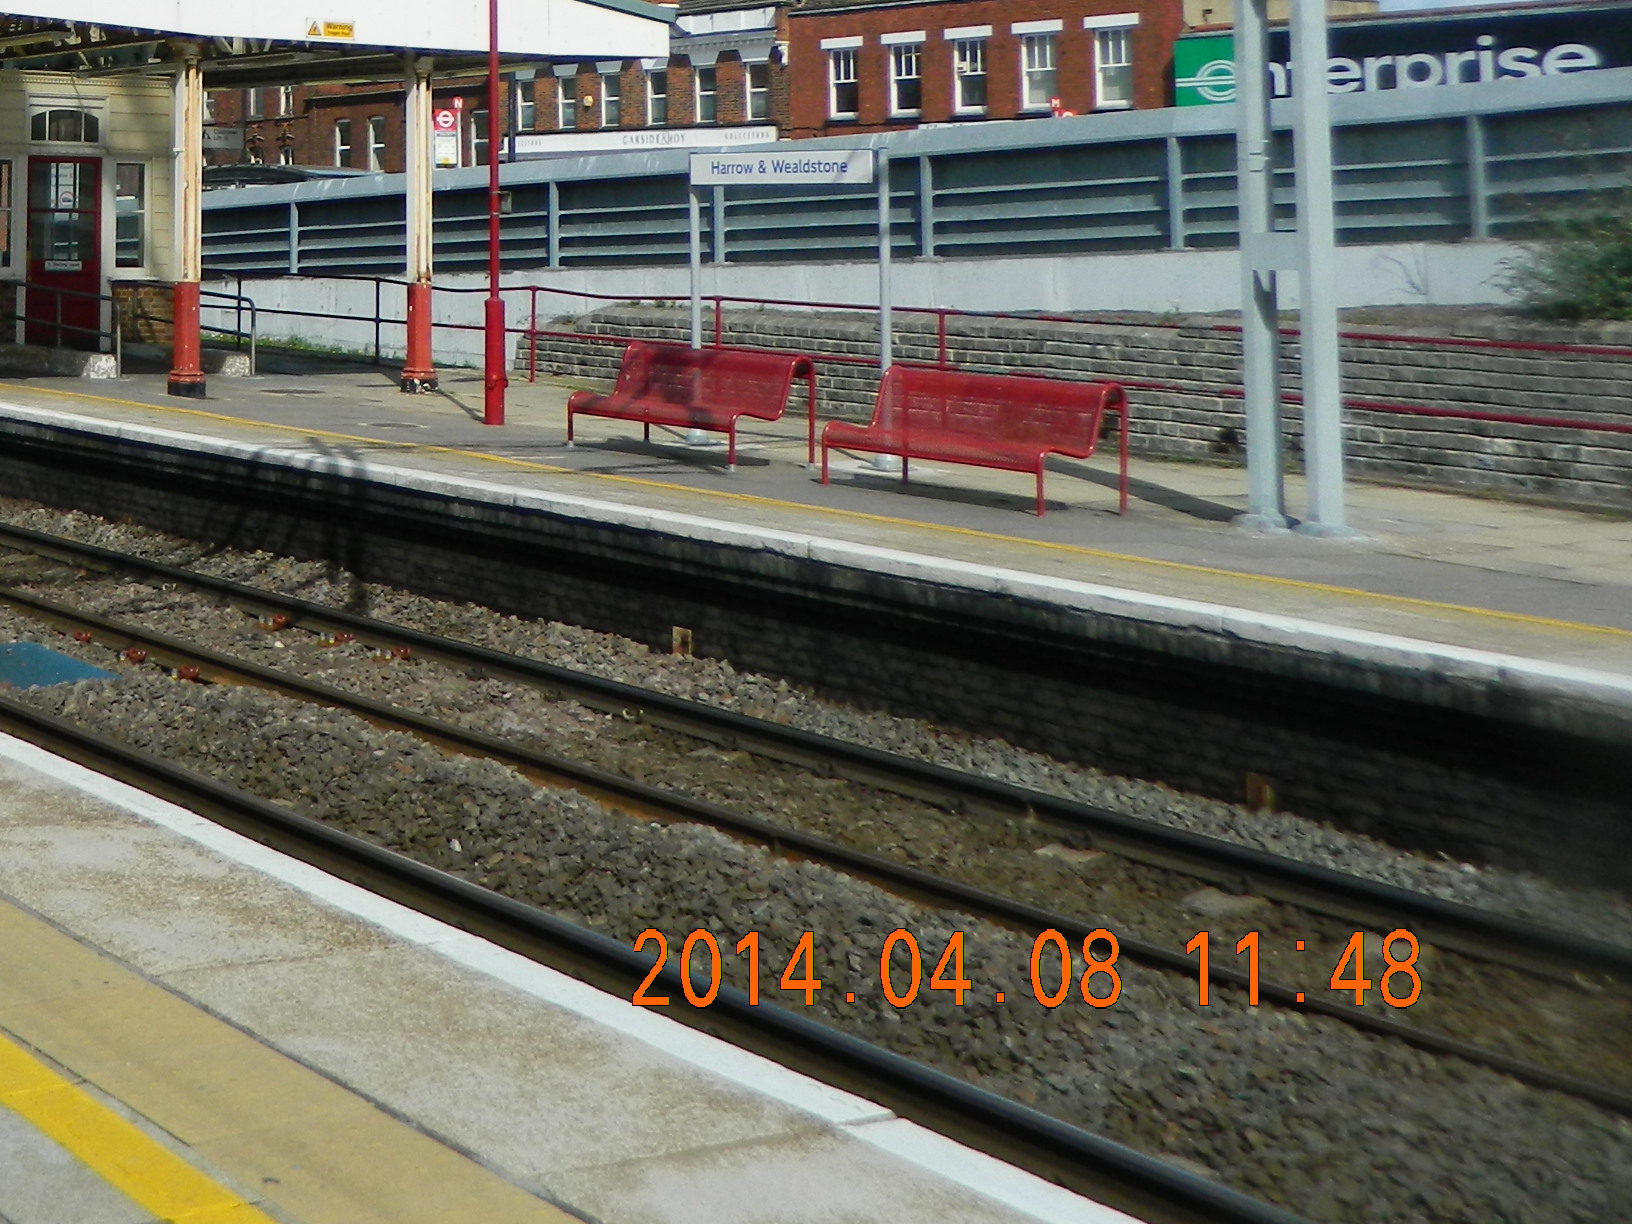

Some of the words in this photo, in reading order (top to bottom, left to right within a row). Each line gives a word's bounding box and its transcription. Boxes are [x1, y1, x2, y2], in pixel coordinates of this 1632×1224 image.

[1196, 35, 1600, 101] enerprise
[711, 161, 754, 175] Harrow
[758, 160, 767, 173] &
[771, 159, 848, 173] Wealdstone
